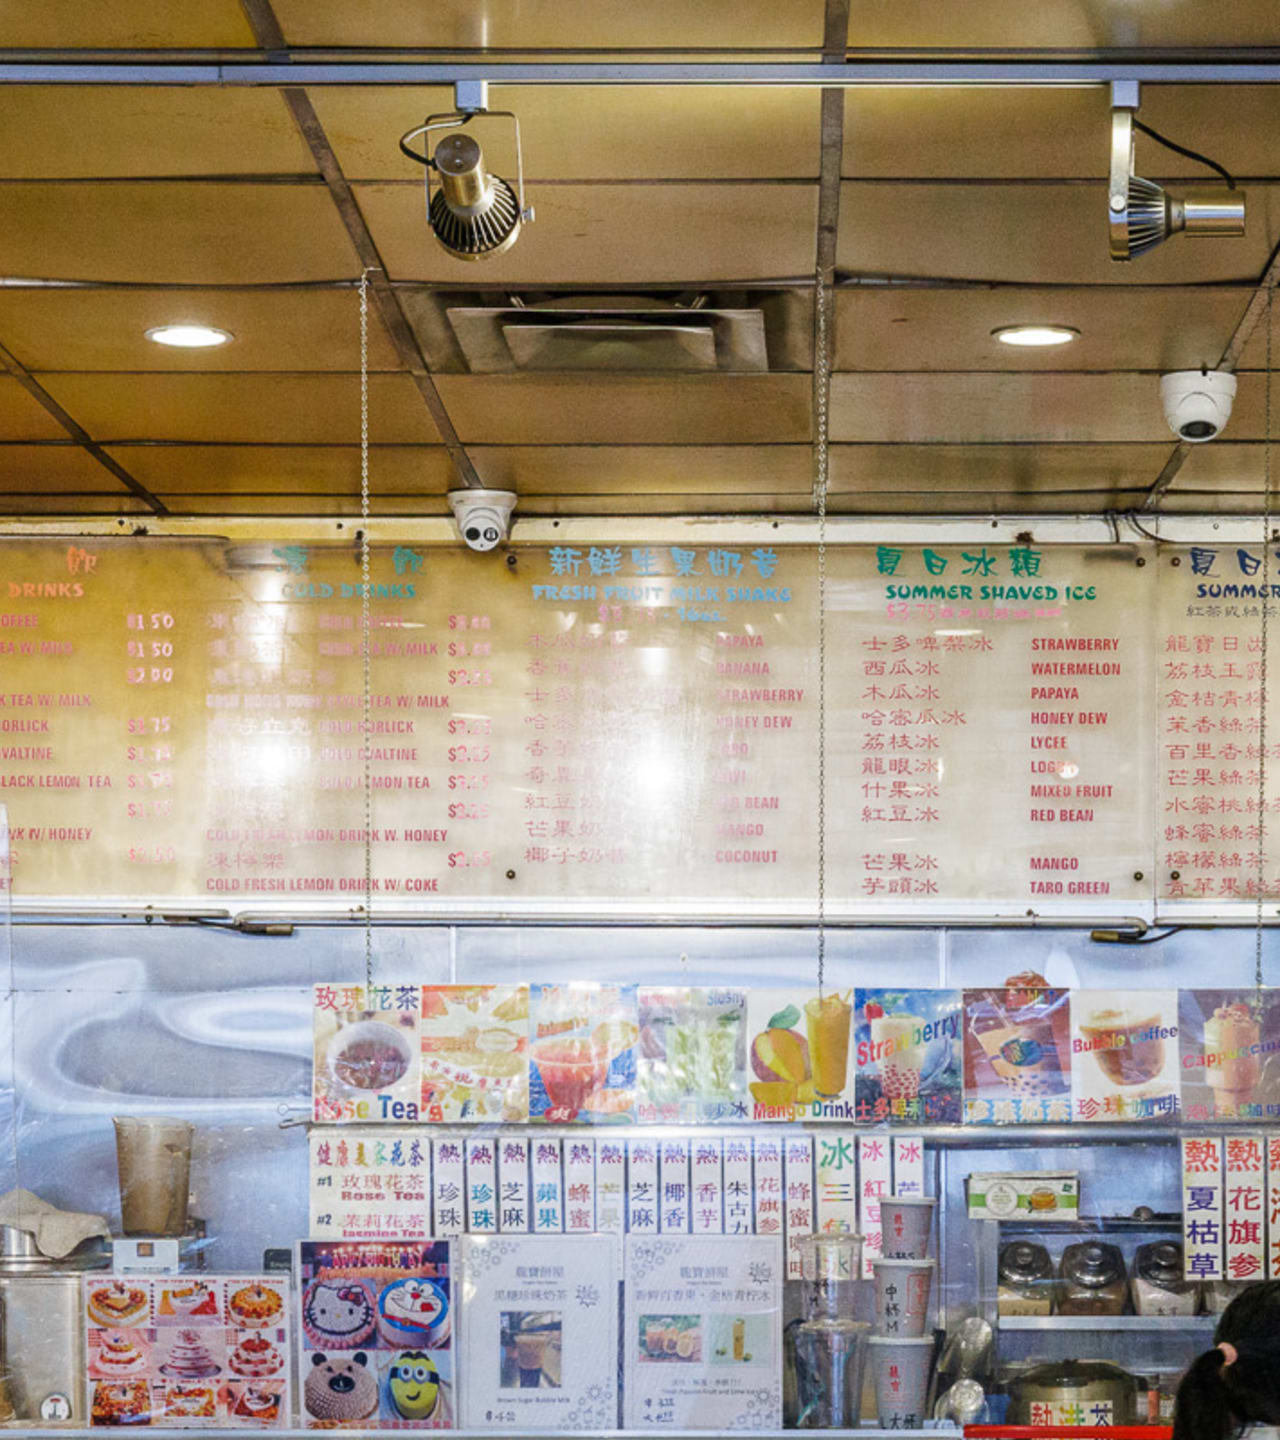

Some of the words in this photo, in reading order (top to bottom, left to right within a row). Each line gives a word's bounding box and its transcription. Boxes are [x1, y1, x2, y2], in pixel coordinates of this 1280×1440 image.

[8, 582, 85, 598] DRINKS
[341, 583, 416, 599] DRINKS
[533, 586, 596, 601] FRESH
[604, 586, 663, 601] FRUIT
[670, 586, 718, 601] MILK
[726, 586, 792, 601] SHAKE
[886, 585, 974, 600] SUMMER
[979, 585, 1058, 600] SHAVED
[1065, 585, 1097, 600] ICE
[40, 641, 73, 655] MILK
[405, 643, 438, 656] MILK
[1031, 637, 1119, 651] STRAWBERRY
[861, 659, 941, 676] 西瓜冰
[1031, 662, 1120, 676] WATERMELON
[717, 689, 804, 702] STRAWBERRY
[861, 683, 941, 701] 木瓜冰
[1031, 687, 1079, 700] PAPAYA
[10, 694, 33, 707] TEA
[58, 694, 91, 707] MILK
[370, 695, 392, 708] TEA
[417, 695, 449, 708] MILK
[763, 716, 793, 729] DEW
[1030, 711, 1074, 725] HONEY
[1078, 711, 1108, 725] DEW
[1030, 736, 1068, 749] LYCEE
[38, 775, 81, 788] LEMON
[87, 775, 112, 788] TEA
[407, 775, 431, 789] TEA
[1030, 784, 1072, 798] MIXED
[1076, 784, 1113, 798] FRUIT
[744, 796, 779, 809] BEAN
[861, 805, 940, 823] 紅豆冰
[1030, 809, 1055, 822] RED
[1059, 809, 1094, 822] BEAN
[48, 827, 93, 841] HONEY
[404, 829, 448, 842] HONEY
[715, 850, 778, 864] COCONUT
[861, 853, 939, 871] 芒果冰
[1030, 857, 1079, 870] MANGO
[206, 878, 240, 891] COLD
[245, 878, 285, 891] FRESH
[289, 878, 334, 891] LEMON
[340, 878, 379, 891] DRINK
[405, 878, 439, 891] COKE
[1030, 881, 1064, 894] TARO
[1068, 881, 1110, 894] GREEN
[315, 986, 418, 1012] 玫瑰花茶
[856, 1013, 960, 1066] Strawberry
[1073, 1030, 1125, 1053] Bubble
[1130, 1025, 1179, 1044] coffee
[377, 1095, 418, 1120] Tea
[753, 1102, 806, 1122] Mango
[811, 1102, 853, 1120] Drink
[341, 1174, 424, 1191] 玫瑰花茶
